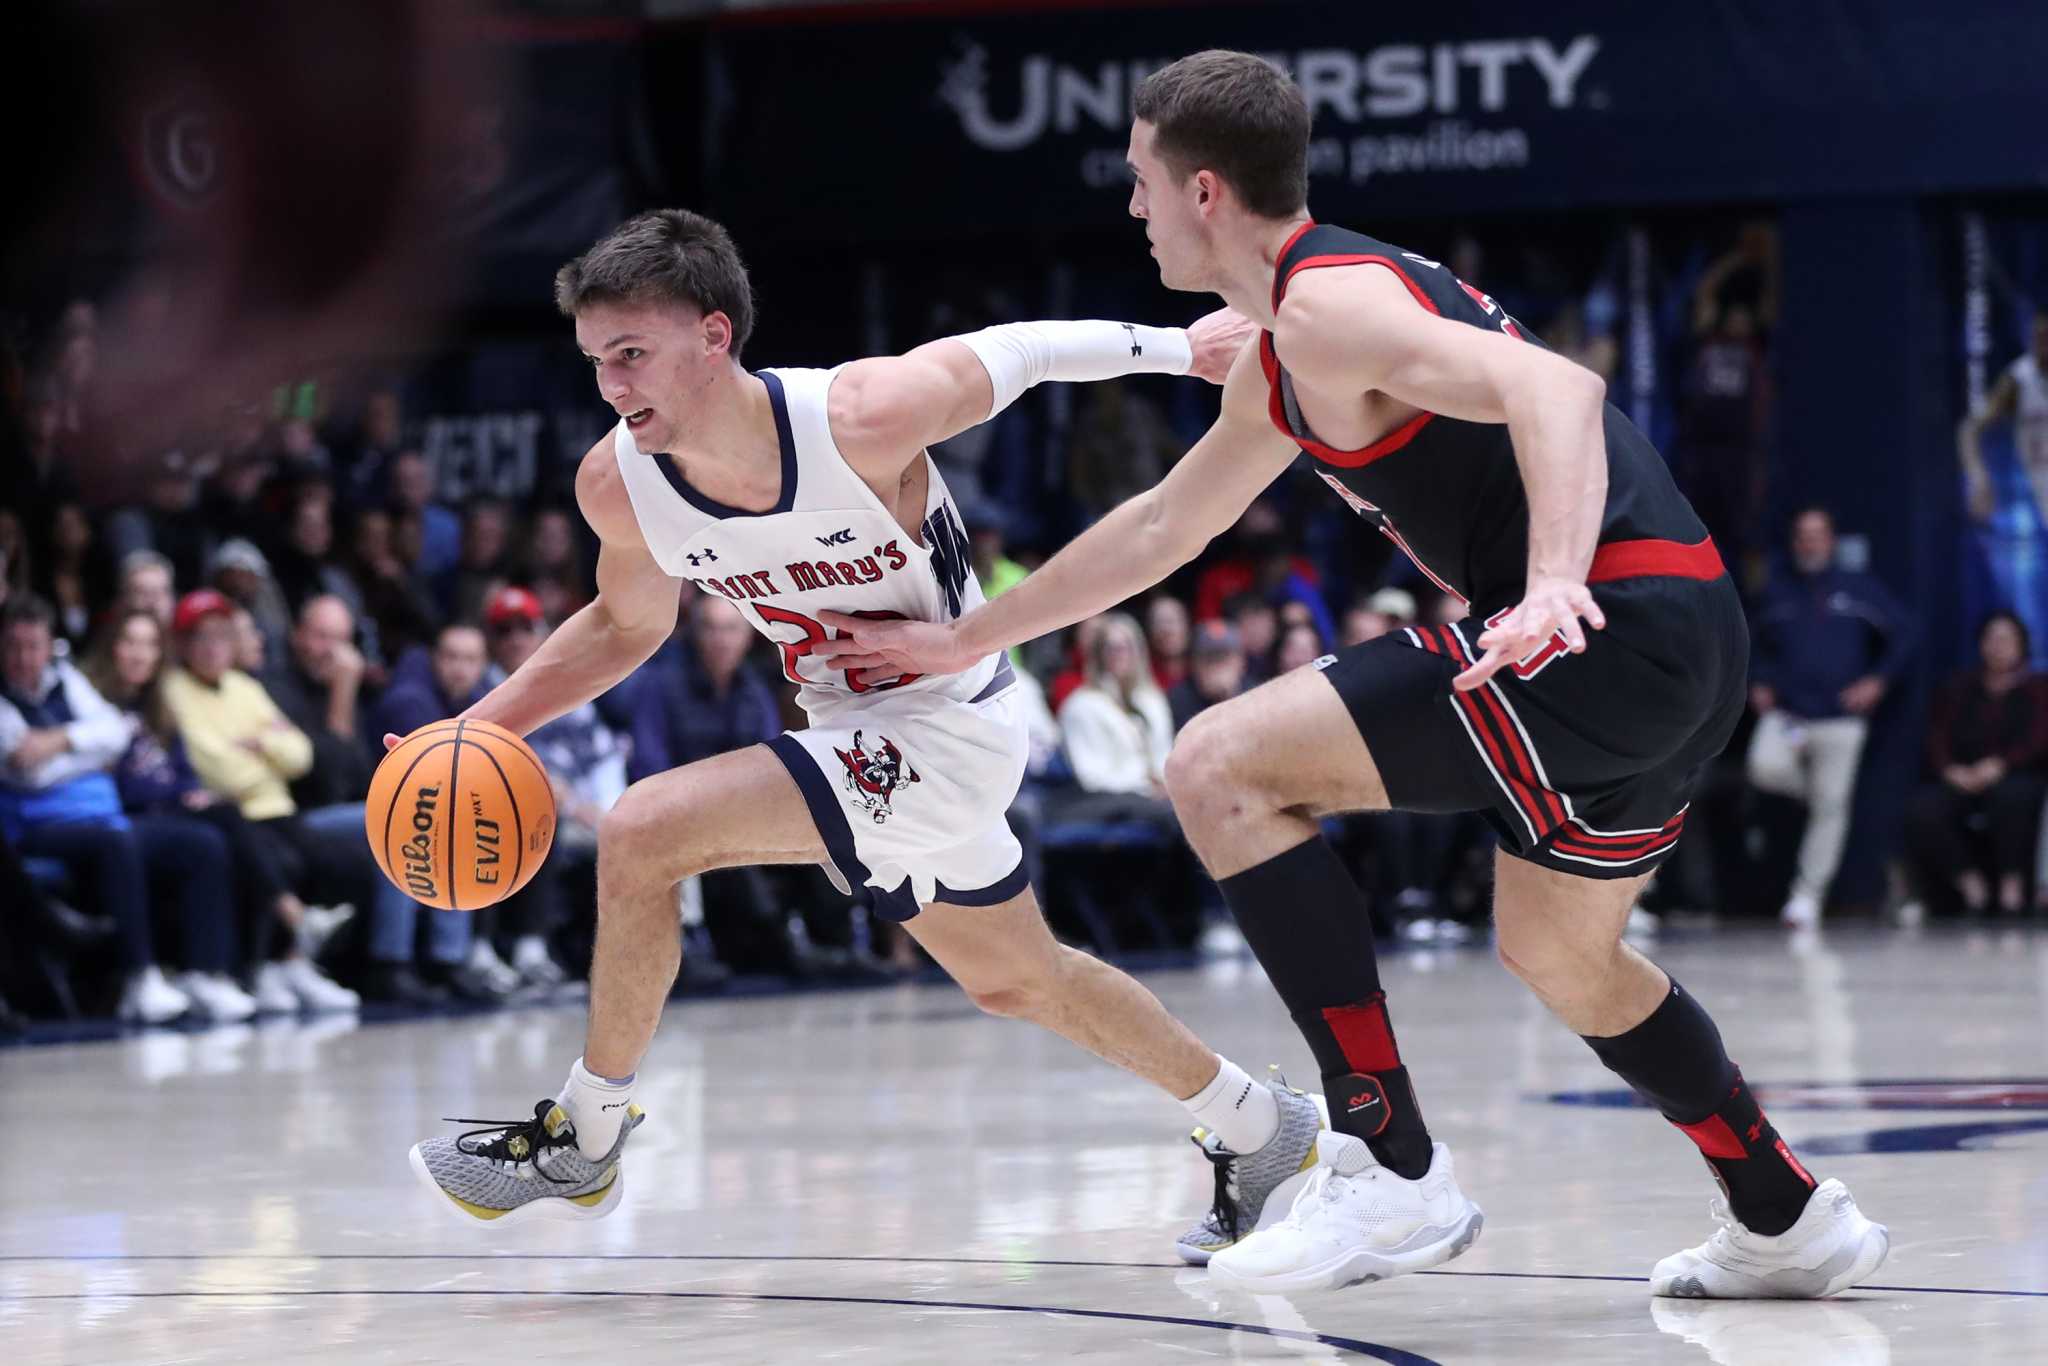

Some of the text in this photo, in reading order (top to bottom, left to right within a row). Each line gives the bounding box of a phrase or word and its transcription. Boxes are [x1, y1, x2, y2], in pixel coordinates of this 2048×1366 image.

[1349, 119, 1529, 184] pavilion
[815, 528, 857, 547] WCC
[694, 539, 907, 601] AINT MARY'S
[402, 787, 438, 898] Wilson
